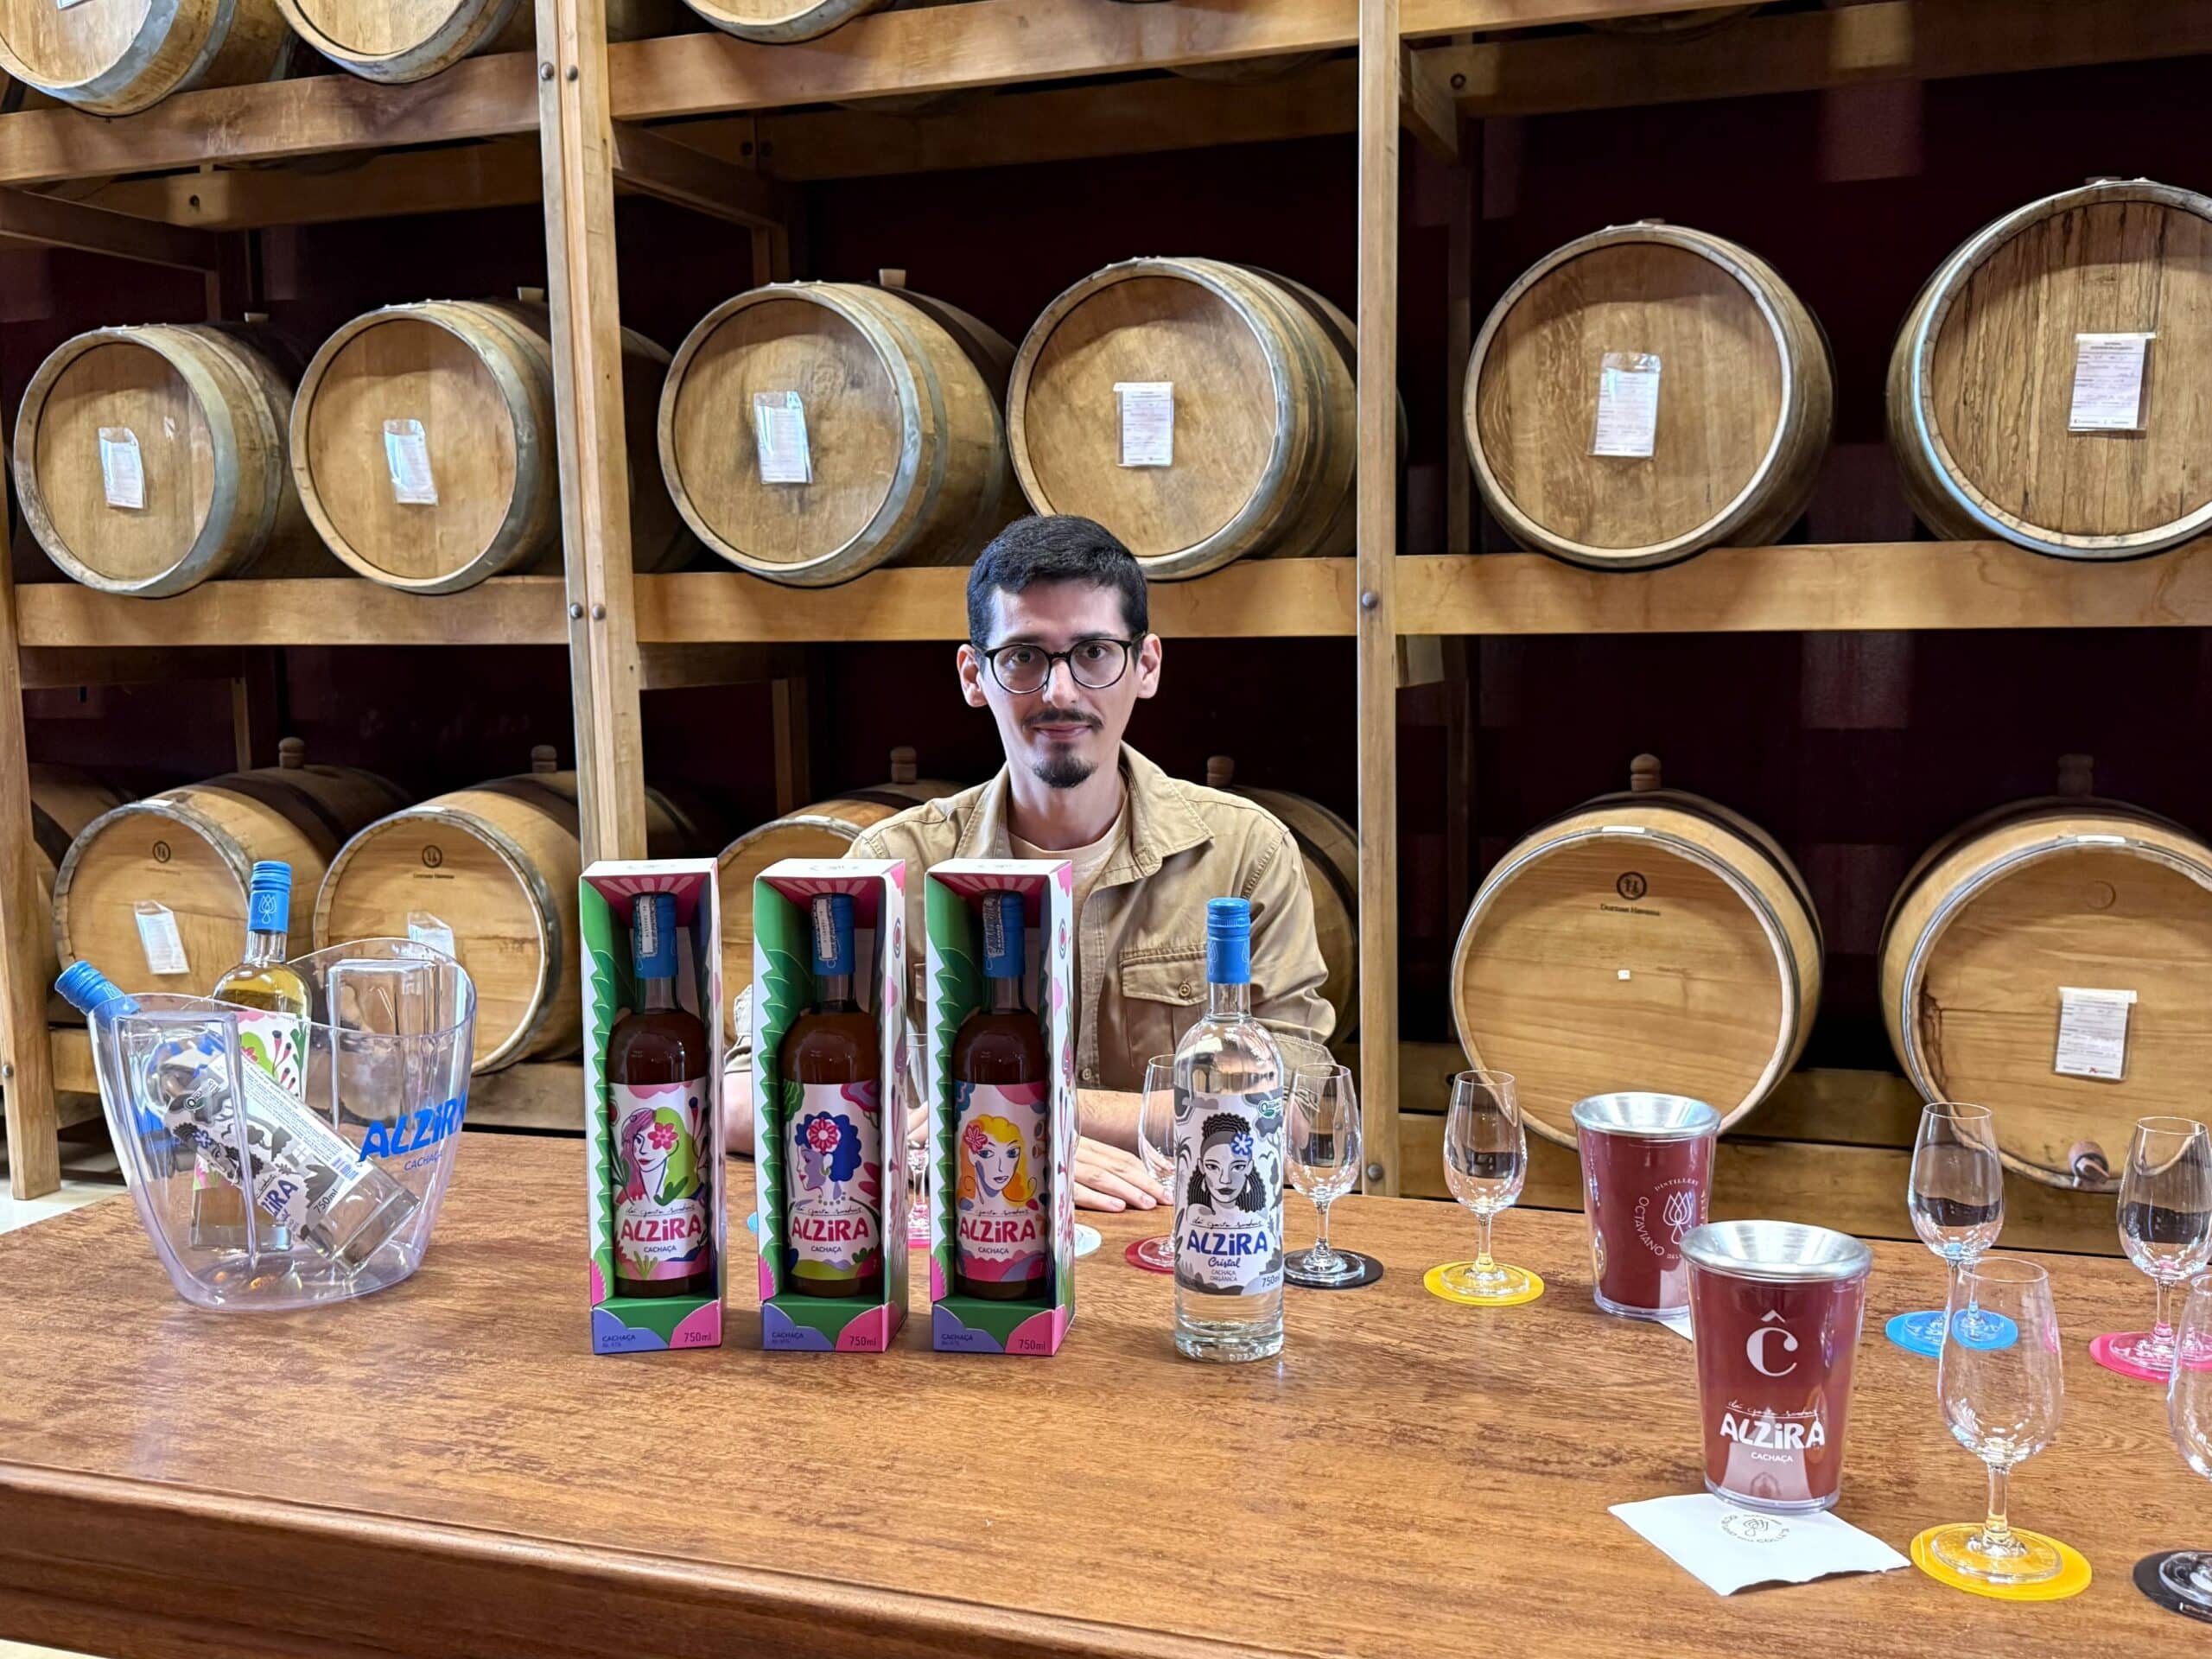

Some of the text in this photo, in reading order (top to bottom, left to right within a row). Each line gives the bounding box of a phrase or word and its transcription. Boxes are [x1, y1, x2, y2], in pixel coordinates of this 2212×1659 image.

[313, 1188, 339, 1214] 750ml
[621, 1214, 702, 1243] ALZiRA
[791, 1217, 869, 1243] ALZiRA
[959, 1217, 1036, 1243] ALZiRA
[1634, 1197, 1665, 1256] OCTAVIANO
[643, 1245, 677, 1254] CACHAÇA
[810, 1245, 842, 1254] CACHAÇA
[1186, 1229, 1268, 1255] ALZiRA
[1208, 1256, 1241, 1268] Cristal
[683, 1332, 712, 1343] 750ml
[849, 1336, 876, 1347] 750ml
[1019, 1338, 1046, 1351] 750ml
[1719, 1412, 1825, 1450] ALZiRA
[1751, 1452, 1794, 1464] CACHAÇA
